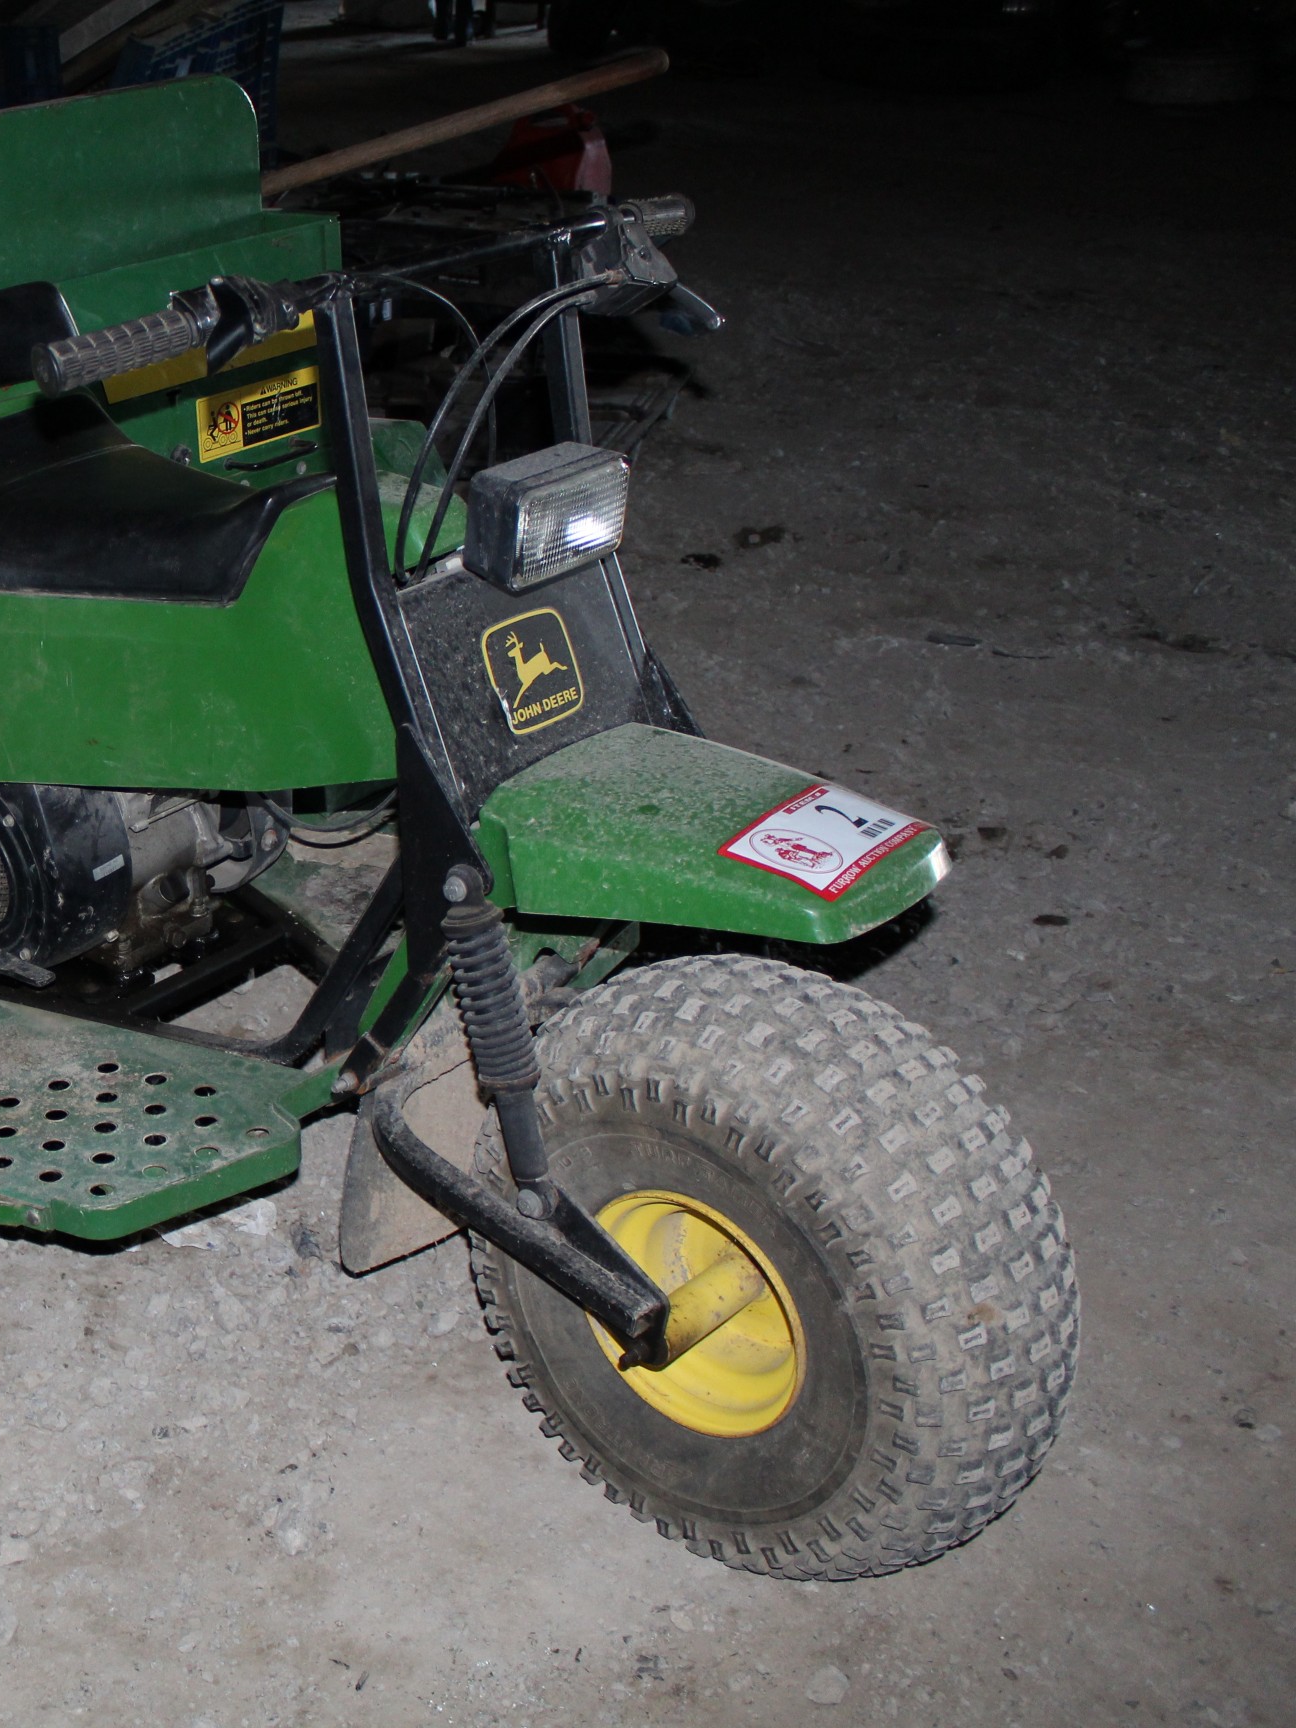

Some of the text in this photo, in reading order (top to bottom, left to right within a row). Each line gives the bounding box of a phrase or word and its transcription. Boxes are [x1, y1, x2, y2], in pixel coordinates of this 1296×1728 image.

[267, 377, 298, 393] WARNING
[512, 687, 579, 725] JOHN DEERE
[814, 804, 869, 829] 2
[828, 825, 917, 894] FURROW AUCTION COMPANY
